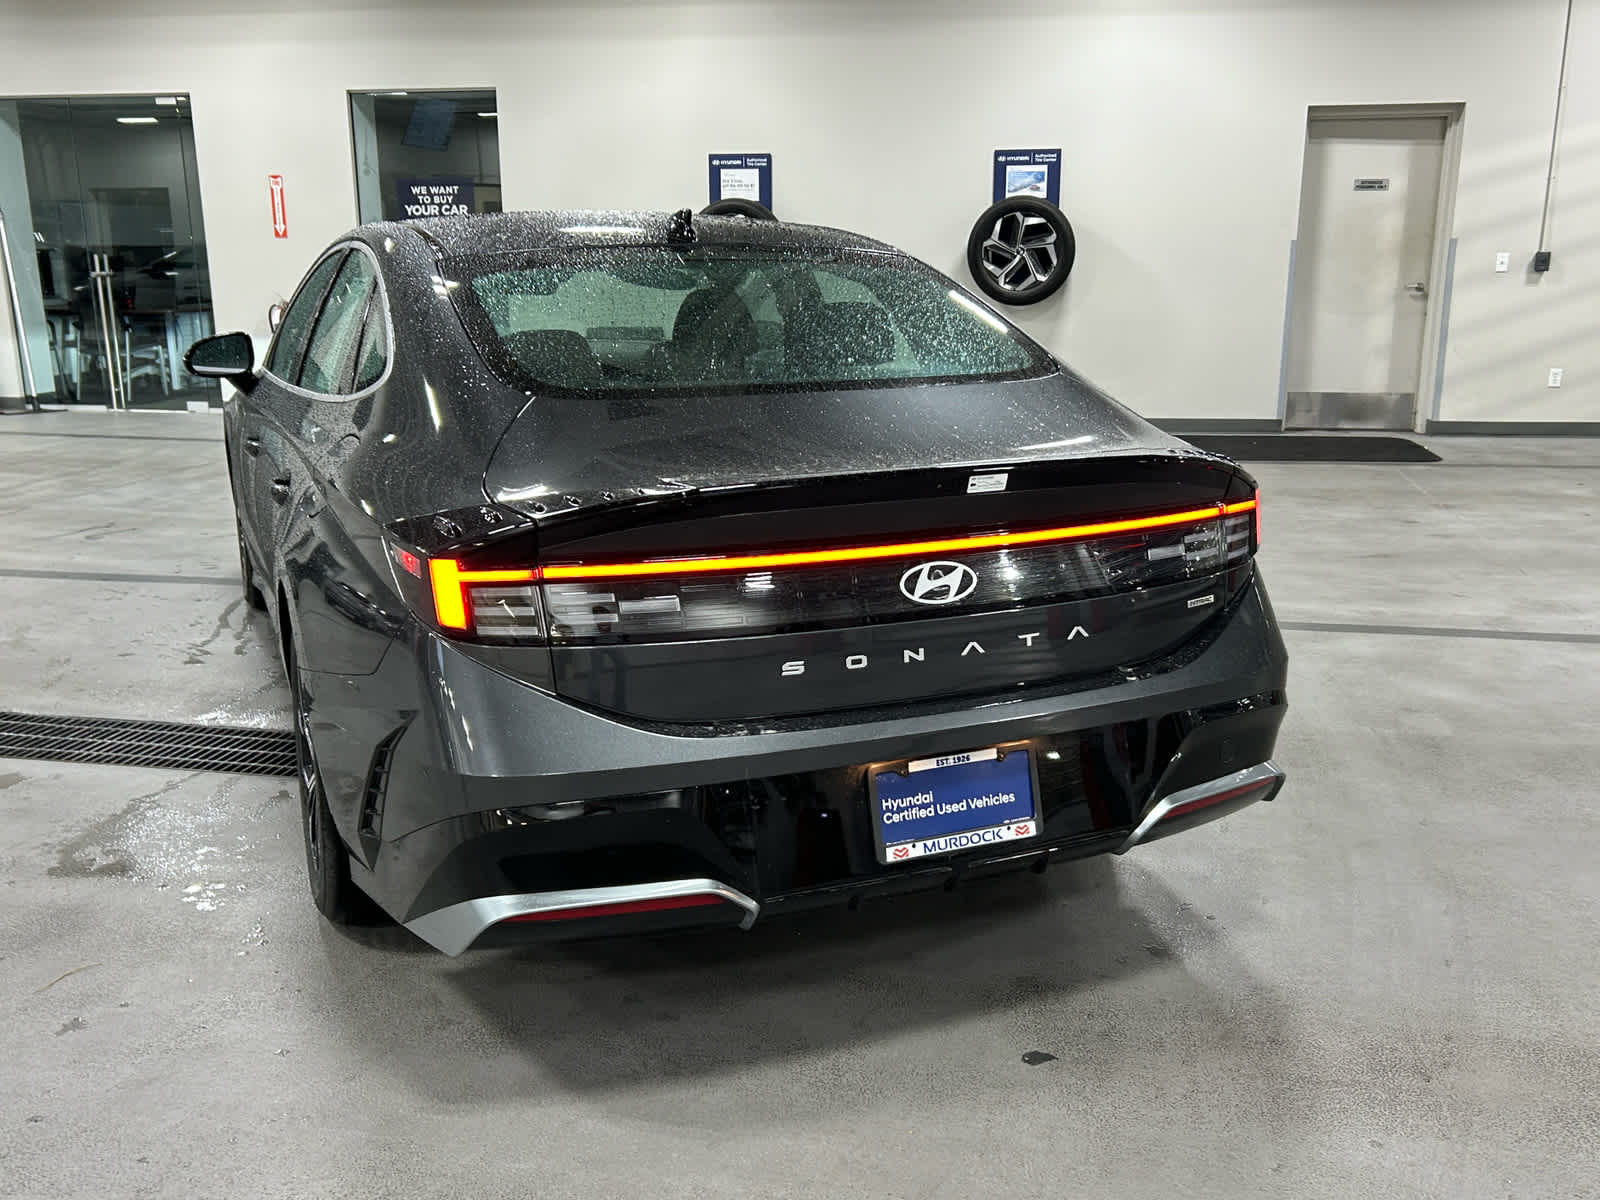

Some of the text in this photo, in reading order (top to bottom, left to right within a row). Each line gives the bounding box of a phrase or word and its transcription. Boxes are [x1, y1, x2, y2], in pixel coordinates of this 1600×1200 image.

[410, 185, 459, 195] WE WANT
[417, 195, 454, 204] TO BUY
[404, 204, 469, 216] YOUR CAR
[781, 625, 1089, 676] SONATA
[952, 754, 971, 764] 1926
[882, 791, 934, 811] Hyundai
[883, 792, 1016, 824] Certified Used Vehicles
[923, 828, 1004, 855] MURDOCK
